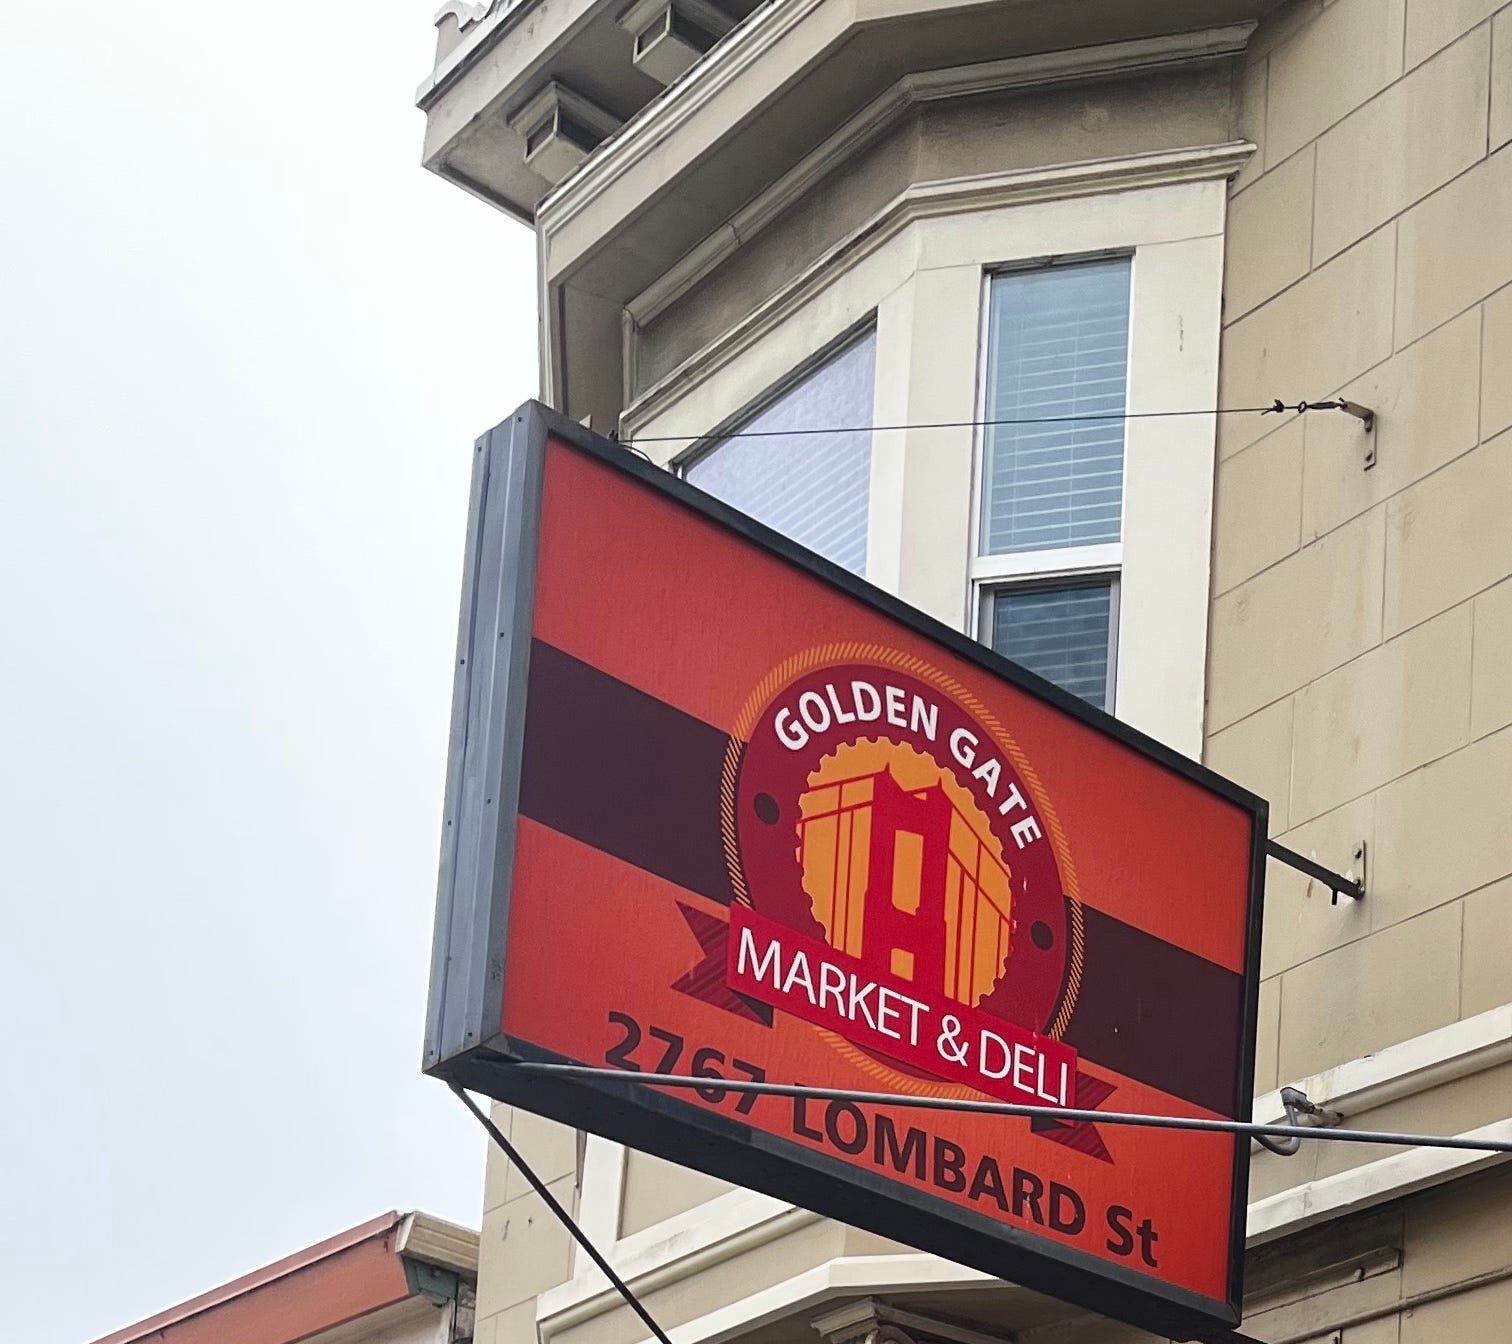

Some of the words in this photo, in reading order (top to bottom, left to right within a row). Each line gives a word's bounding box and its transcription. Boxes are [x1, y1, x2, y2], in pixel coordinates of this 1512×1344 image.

[774, 680, 939, 751] GOLDEN
[949, 727, 1043, 850] GATE
[736, 926, 931, 1046] MARKET
[936, 1014, 970, 1067] &
[978, 1030, 1069, 1107] DELI
[603, 1010, 766, 1117] 2767
[791, 1083, 1087, 1236] LOMBARD
[1105, 1205, 1160, 1268] St
